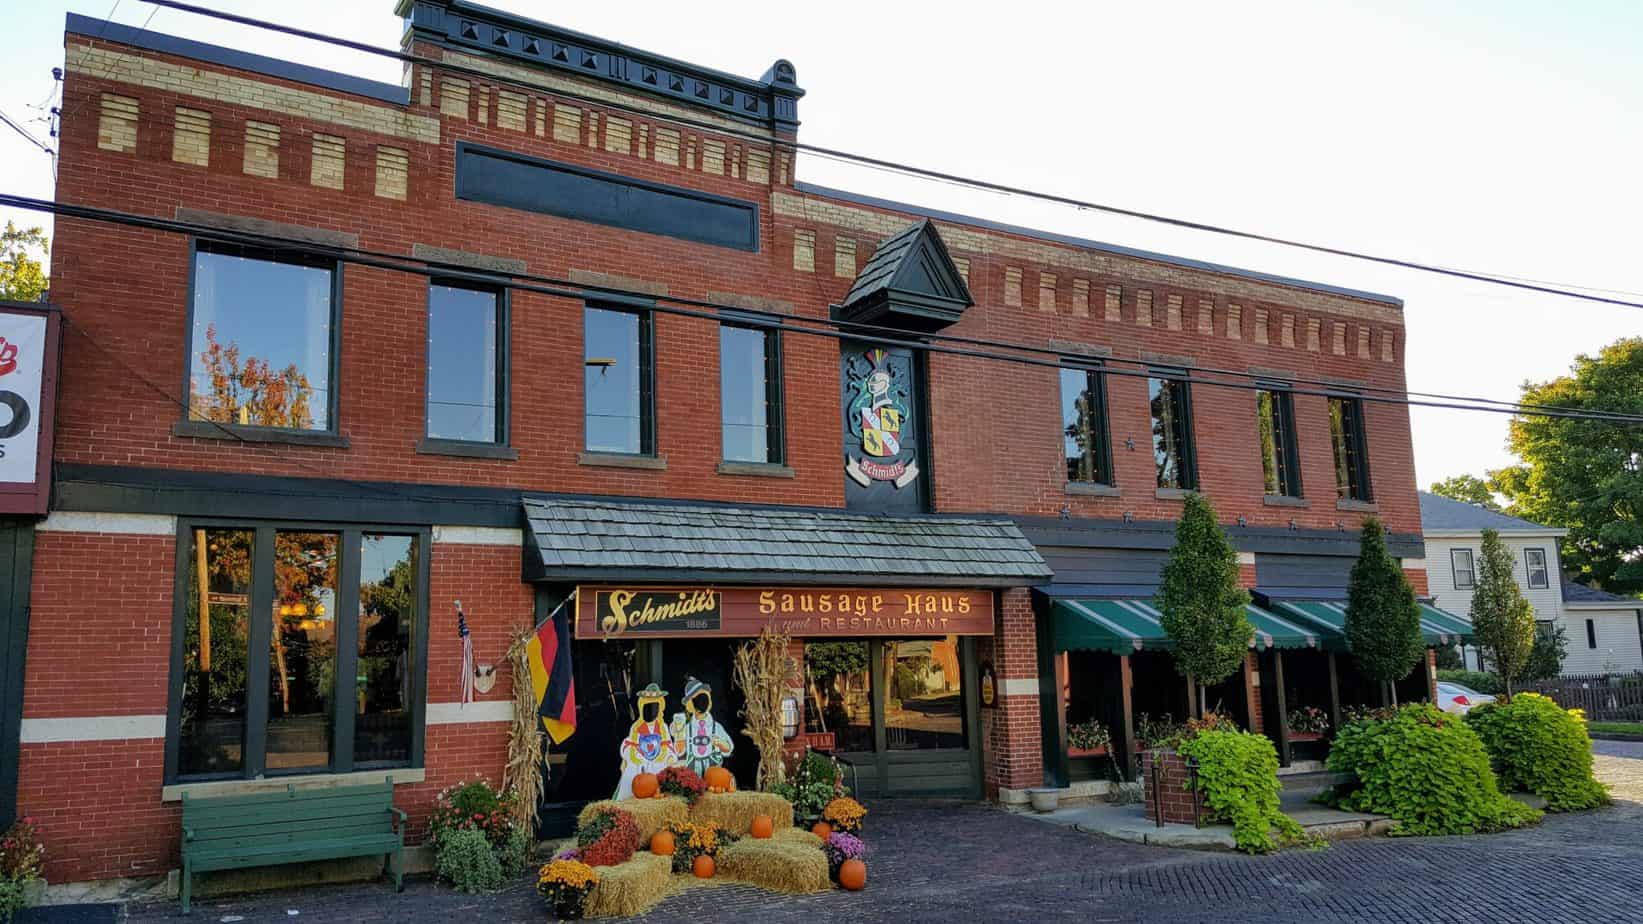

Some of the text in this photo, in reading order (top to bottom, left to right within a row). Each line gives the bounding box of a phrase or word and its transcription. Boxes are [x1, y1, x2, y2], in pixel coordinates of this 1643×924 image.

[602, 588, 716, 638] Schmidt's
[759, 590, 970, 616] Sausage Haus
[820, 617, 949, 630] RESTAURANT
